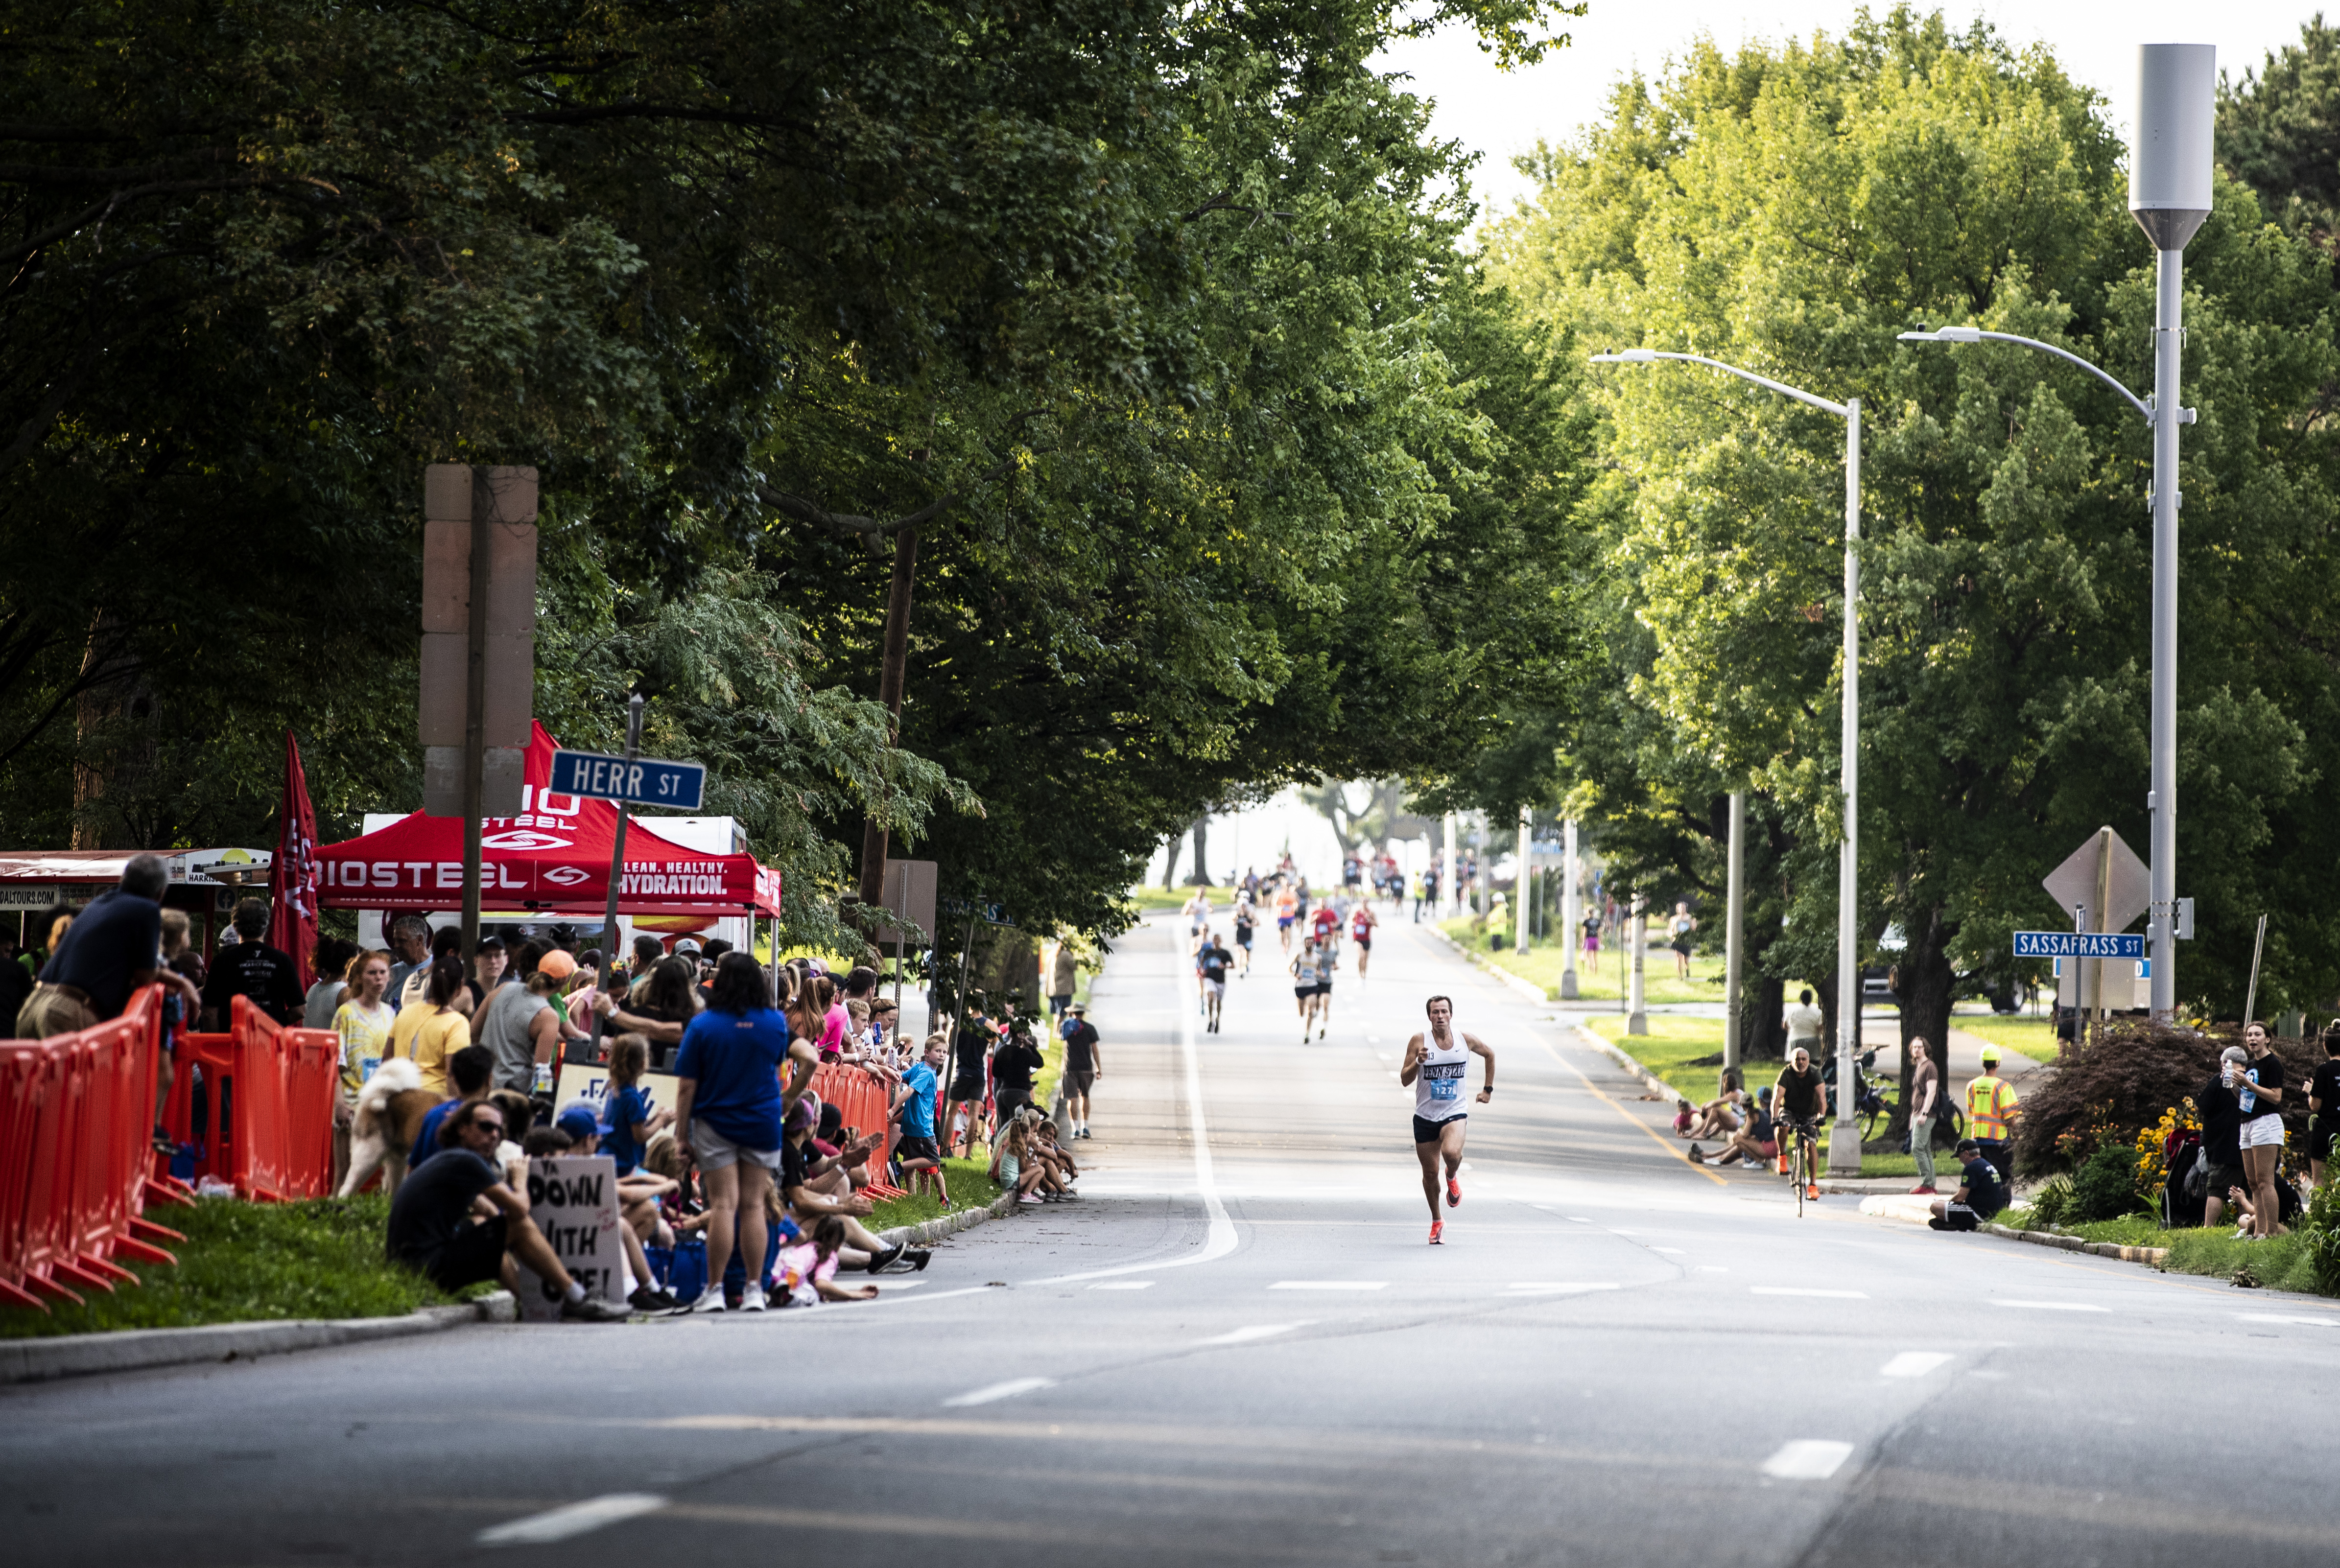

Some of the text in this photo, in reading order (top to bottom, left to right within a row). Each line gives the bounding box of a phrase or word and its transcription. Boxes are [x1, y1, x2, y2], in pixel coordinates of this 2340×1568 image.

[572, 758, 682, 797] HERR ST
[620, 862, 728, 874] LEAN. HEALTHY.
[617, 874, 727, 895] HYDRATION.
[2020, 935, 2139, 955] SASSAFRASS ST
[1423, 1067, 1443, 1078] PENN
[1436, 1086, 1453, 1095] 127
[527, 1174, 603, 1206] DOWN
